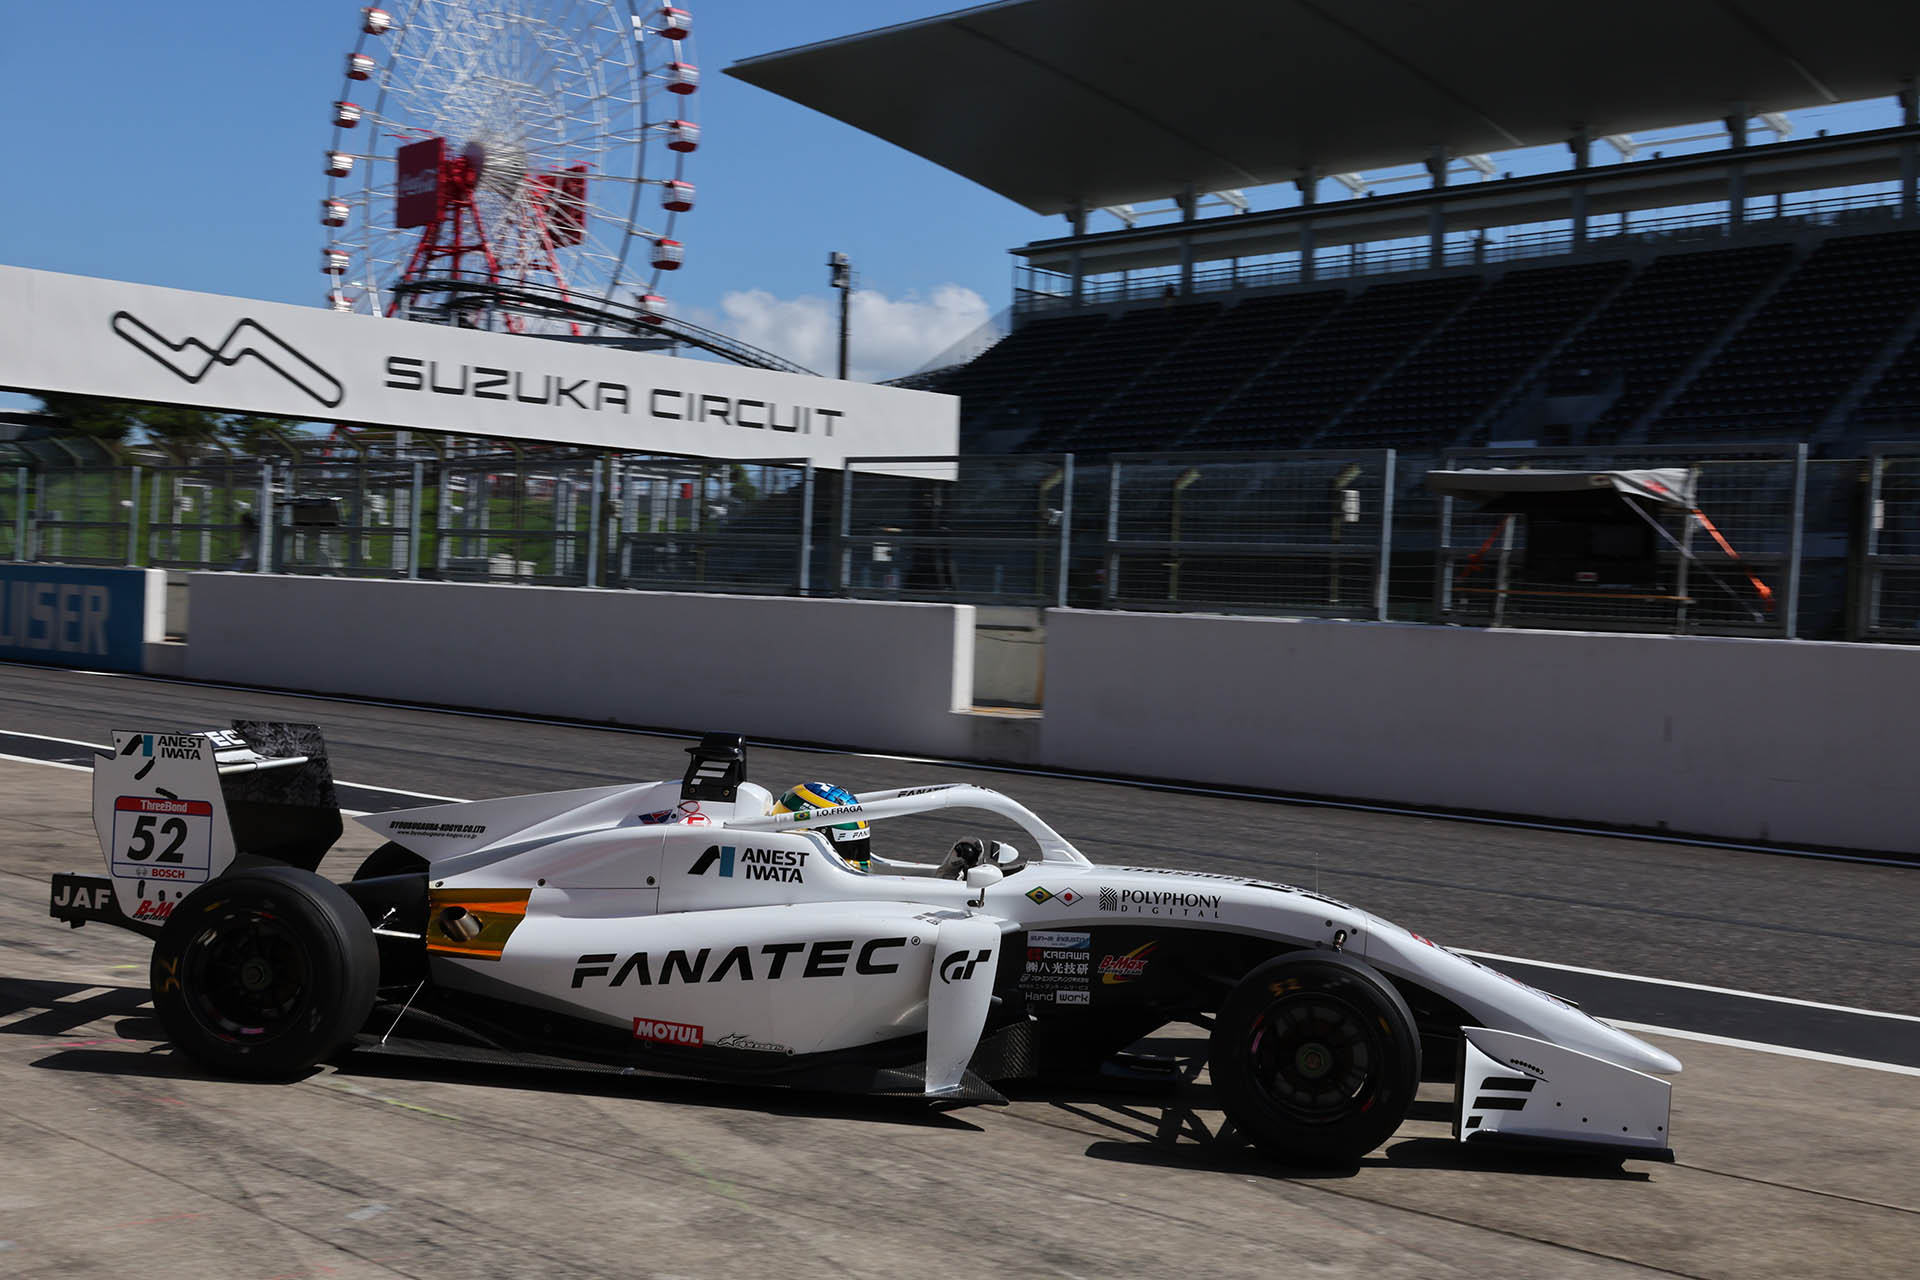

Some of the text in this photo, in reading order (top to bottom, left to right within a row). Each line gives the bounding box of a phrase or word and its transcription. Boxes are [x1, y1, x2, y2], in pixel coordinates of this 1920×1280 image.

[384, 356, 844, 437] SUZUKA CIRCUIT
[158, 735, 205, 749] ANEST
[161, 748, 201, 760] IWATA
[141, 799, 188, 813] ThreeBond
[127, 815, 188, 864] 52
[741, 847, 810, 867] ANEST
[151, 868, 185, 879] BOSCH
[746, 864, 804, 884] IWATA
[54, 885, 111, 910] JAF
[1121, 889, 1222, 909] POLYPHONY
[1121, 904, 1220, 919] DIGITAL
[1043, 950, 1090, 960] KAGAWA
[1025, 991, 1054, 1001] Hand
[636, 1020, 700, 1044] MOTUL
